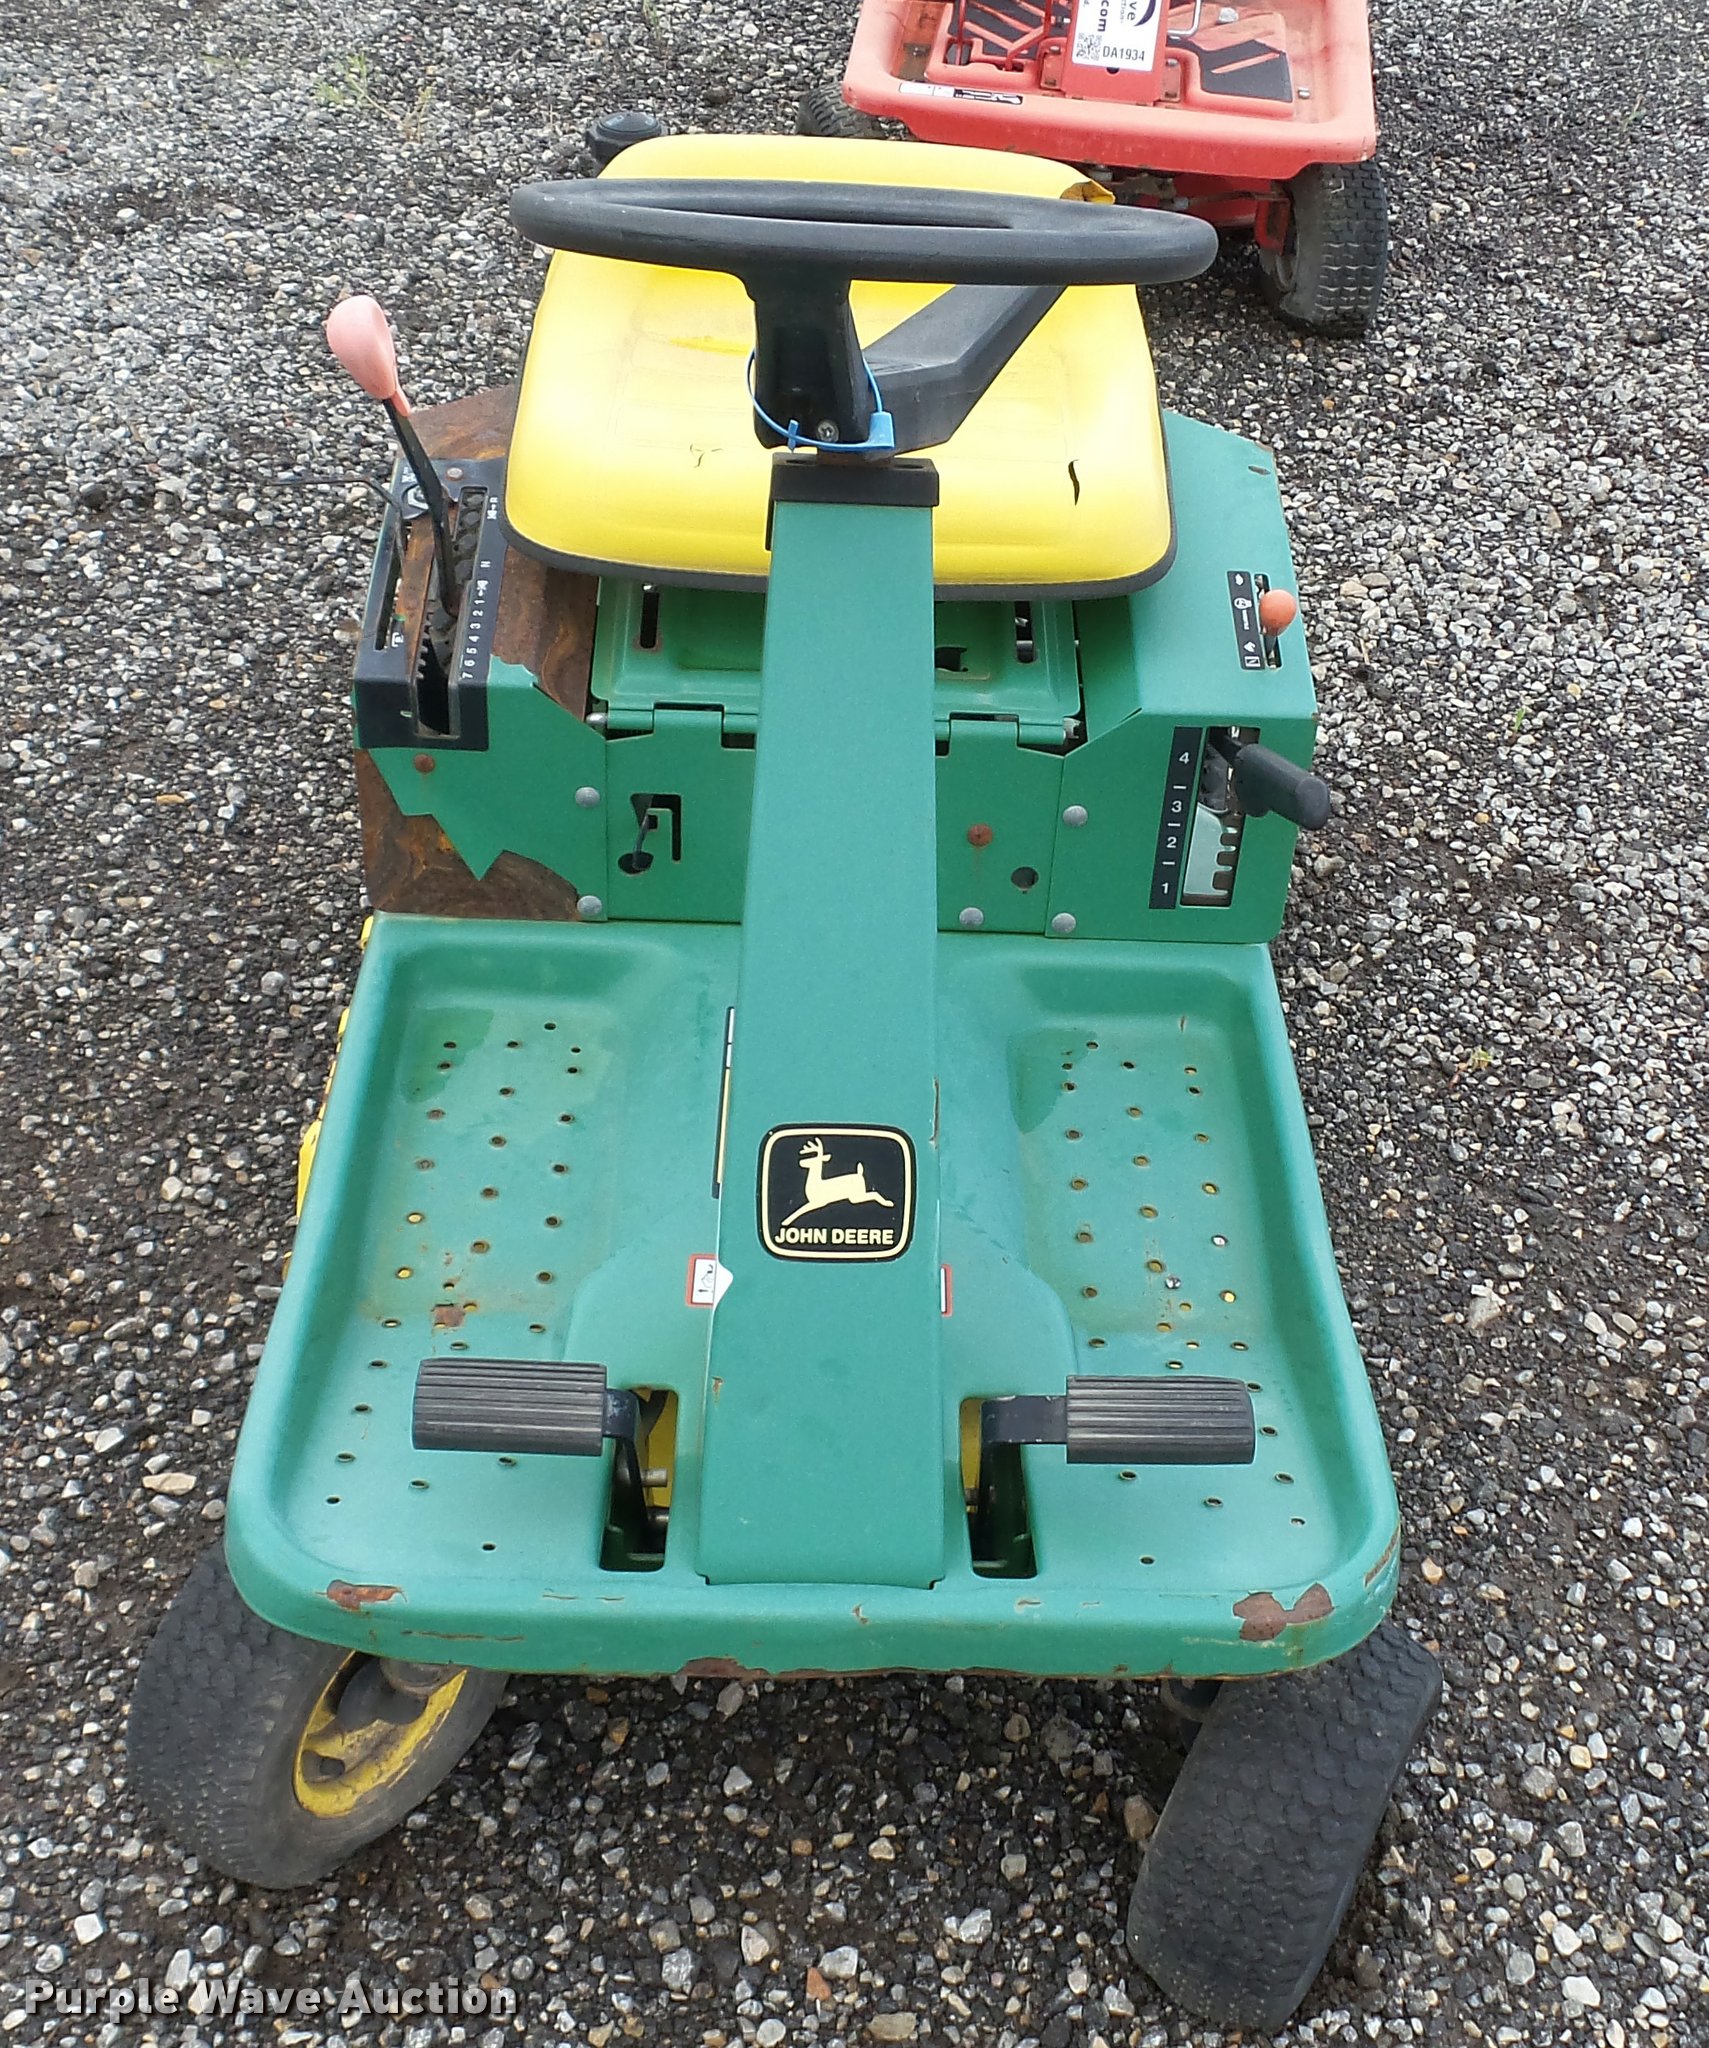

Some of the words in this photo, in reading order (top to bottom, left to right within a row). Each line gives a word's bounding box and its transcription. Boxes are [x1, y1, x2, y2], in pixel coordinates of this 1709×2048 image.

[1103, 46, 1145, 61] DA1934
[469, 622, 481, 630] 3
[468, 635, 480, 643] 4
[466, 647, 477, 655] 5
[1179, 752, 1190, 764] 4
[1171, 801, 1182, 813] 3
[1166, 836, 1177, 848] 2
[1162, 882, 1169, 894] 1
[774, 1228, 828, 1244] JOHN
[831, 1228, 894, 1245] DEERE
